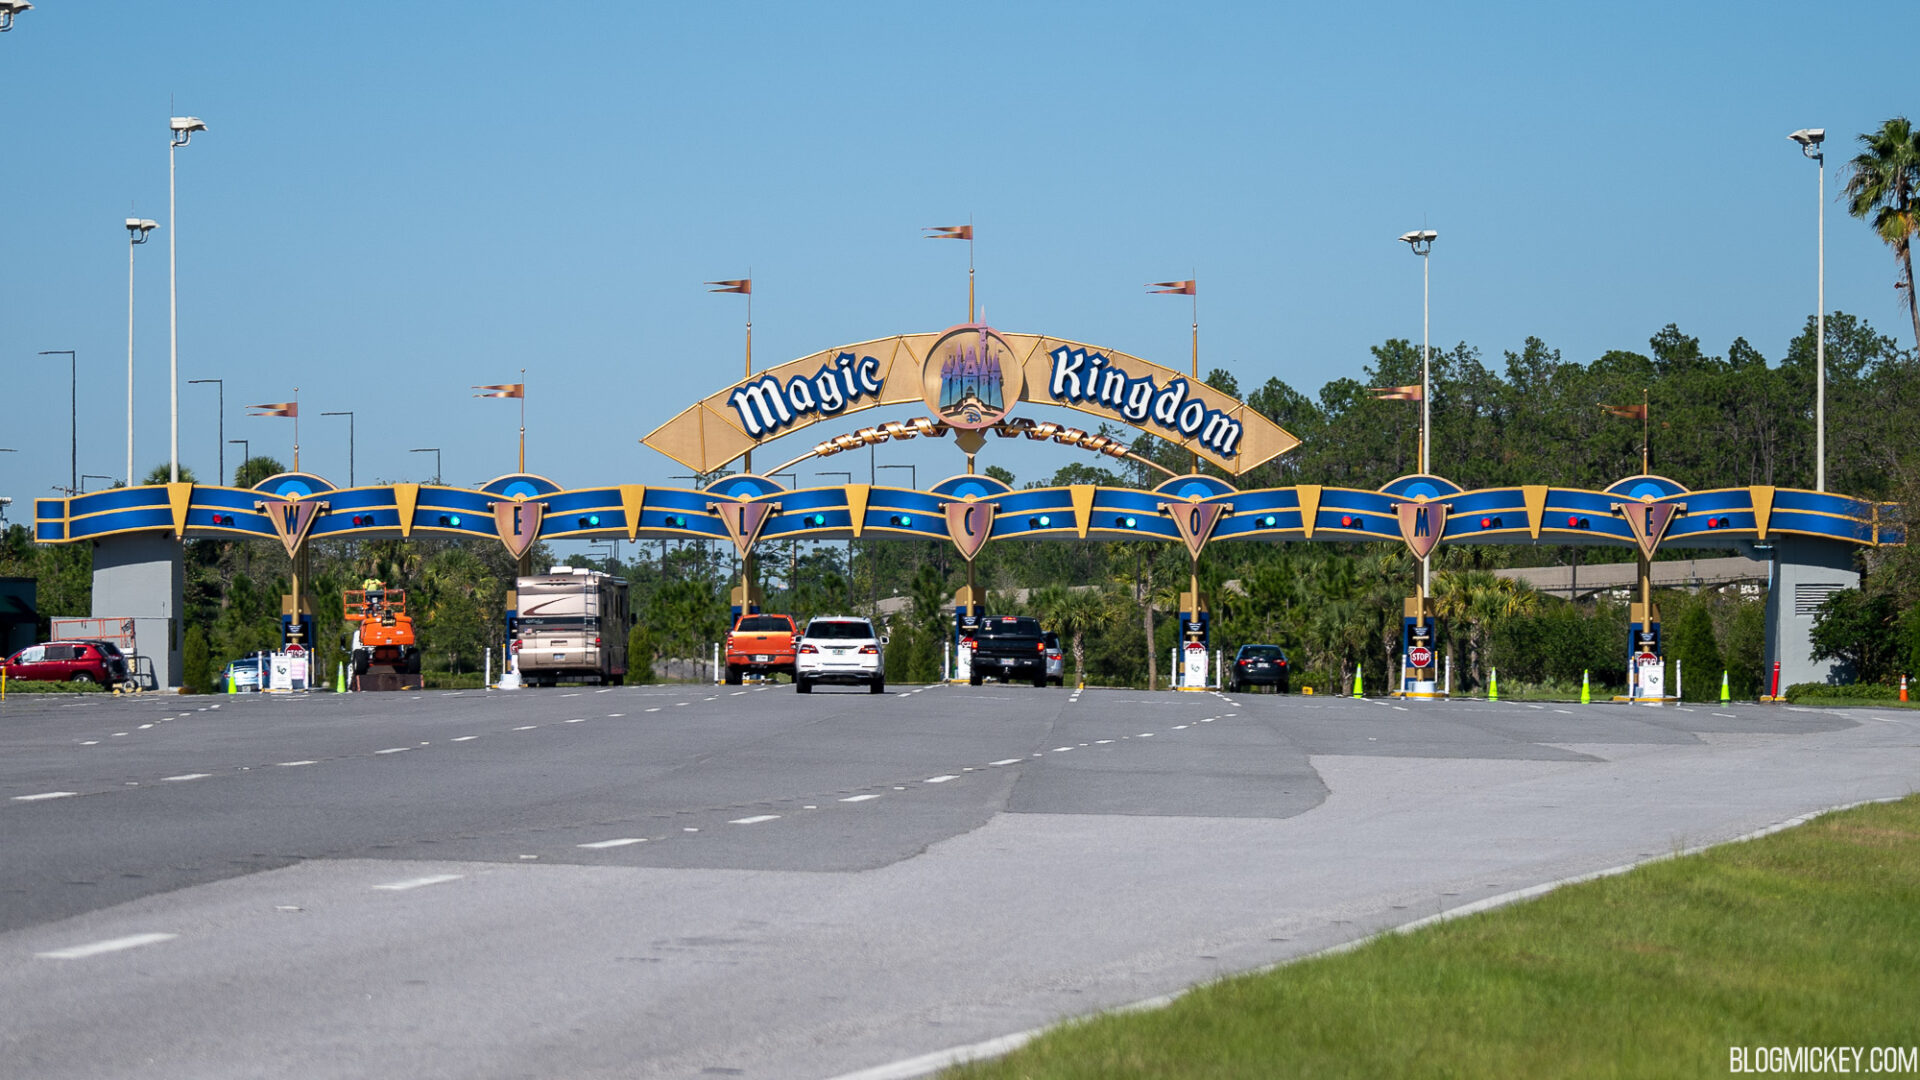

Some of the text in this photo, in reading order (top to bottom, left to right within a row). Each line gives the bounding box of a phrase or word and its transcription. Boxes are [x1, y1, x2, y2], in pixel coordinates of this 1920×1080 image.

[733, 349, 1241, 454] Magic Kingdom
[283, 504, 1654, 537] W E L C O M E
[1412, 653, 1430, 662] STOP
